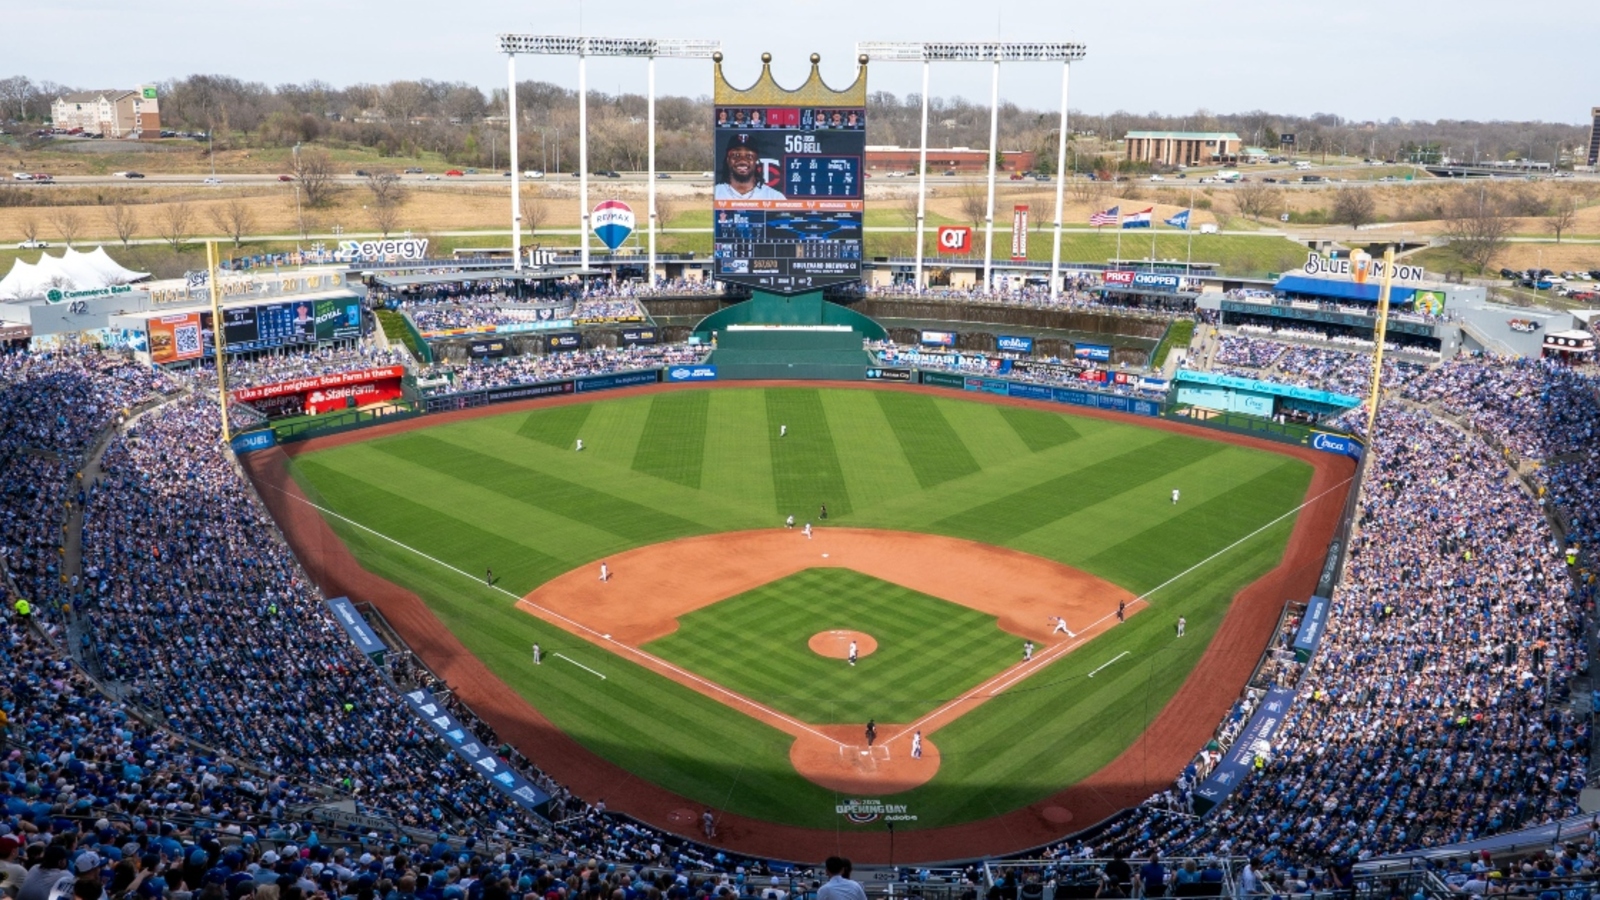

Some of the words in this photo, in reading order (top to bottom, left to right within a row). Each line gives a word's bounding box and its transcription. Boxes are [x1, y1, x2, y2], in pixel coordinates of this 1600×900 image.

[785, 135, 802, 153] 56
[804, 142, 822, 153] BELL
[597, 213, 630, 223] RE/MAX
[941, 229, 966, 249] QT
[363, 241, 426, 258] evergy
[528, 250, 557, 269] Lite
[807, 277, 812, 286] 2
[1106, 272, 1131, 282] PRICE
[1135, 274, 1177, 285] CHOPPER
[63, 289, 110, 299] Commerce
[111, 284, 131, 294] Bank
[151, 286, 195, 304] HALL
[68, 301, 87, 314] 42
[316, 308, 342, 324] ROYAL
[898, 352, 955, 365] FOUNTAIN
[959, 355, 988, 366] DECK
[240, 390, 256, 400] Like
[264, 384, 282, 396] good
[284, 378, 320, 393] neighbor,
[321, 376, 340, 386] State
[342, 373, 362, 383] Farm
[372, 369, 394, 378] there.
[1313, 434, 1345, 451] Circa
[836, 805, 885, 814] OPENING
[885, 805, 907, 813] DAY
